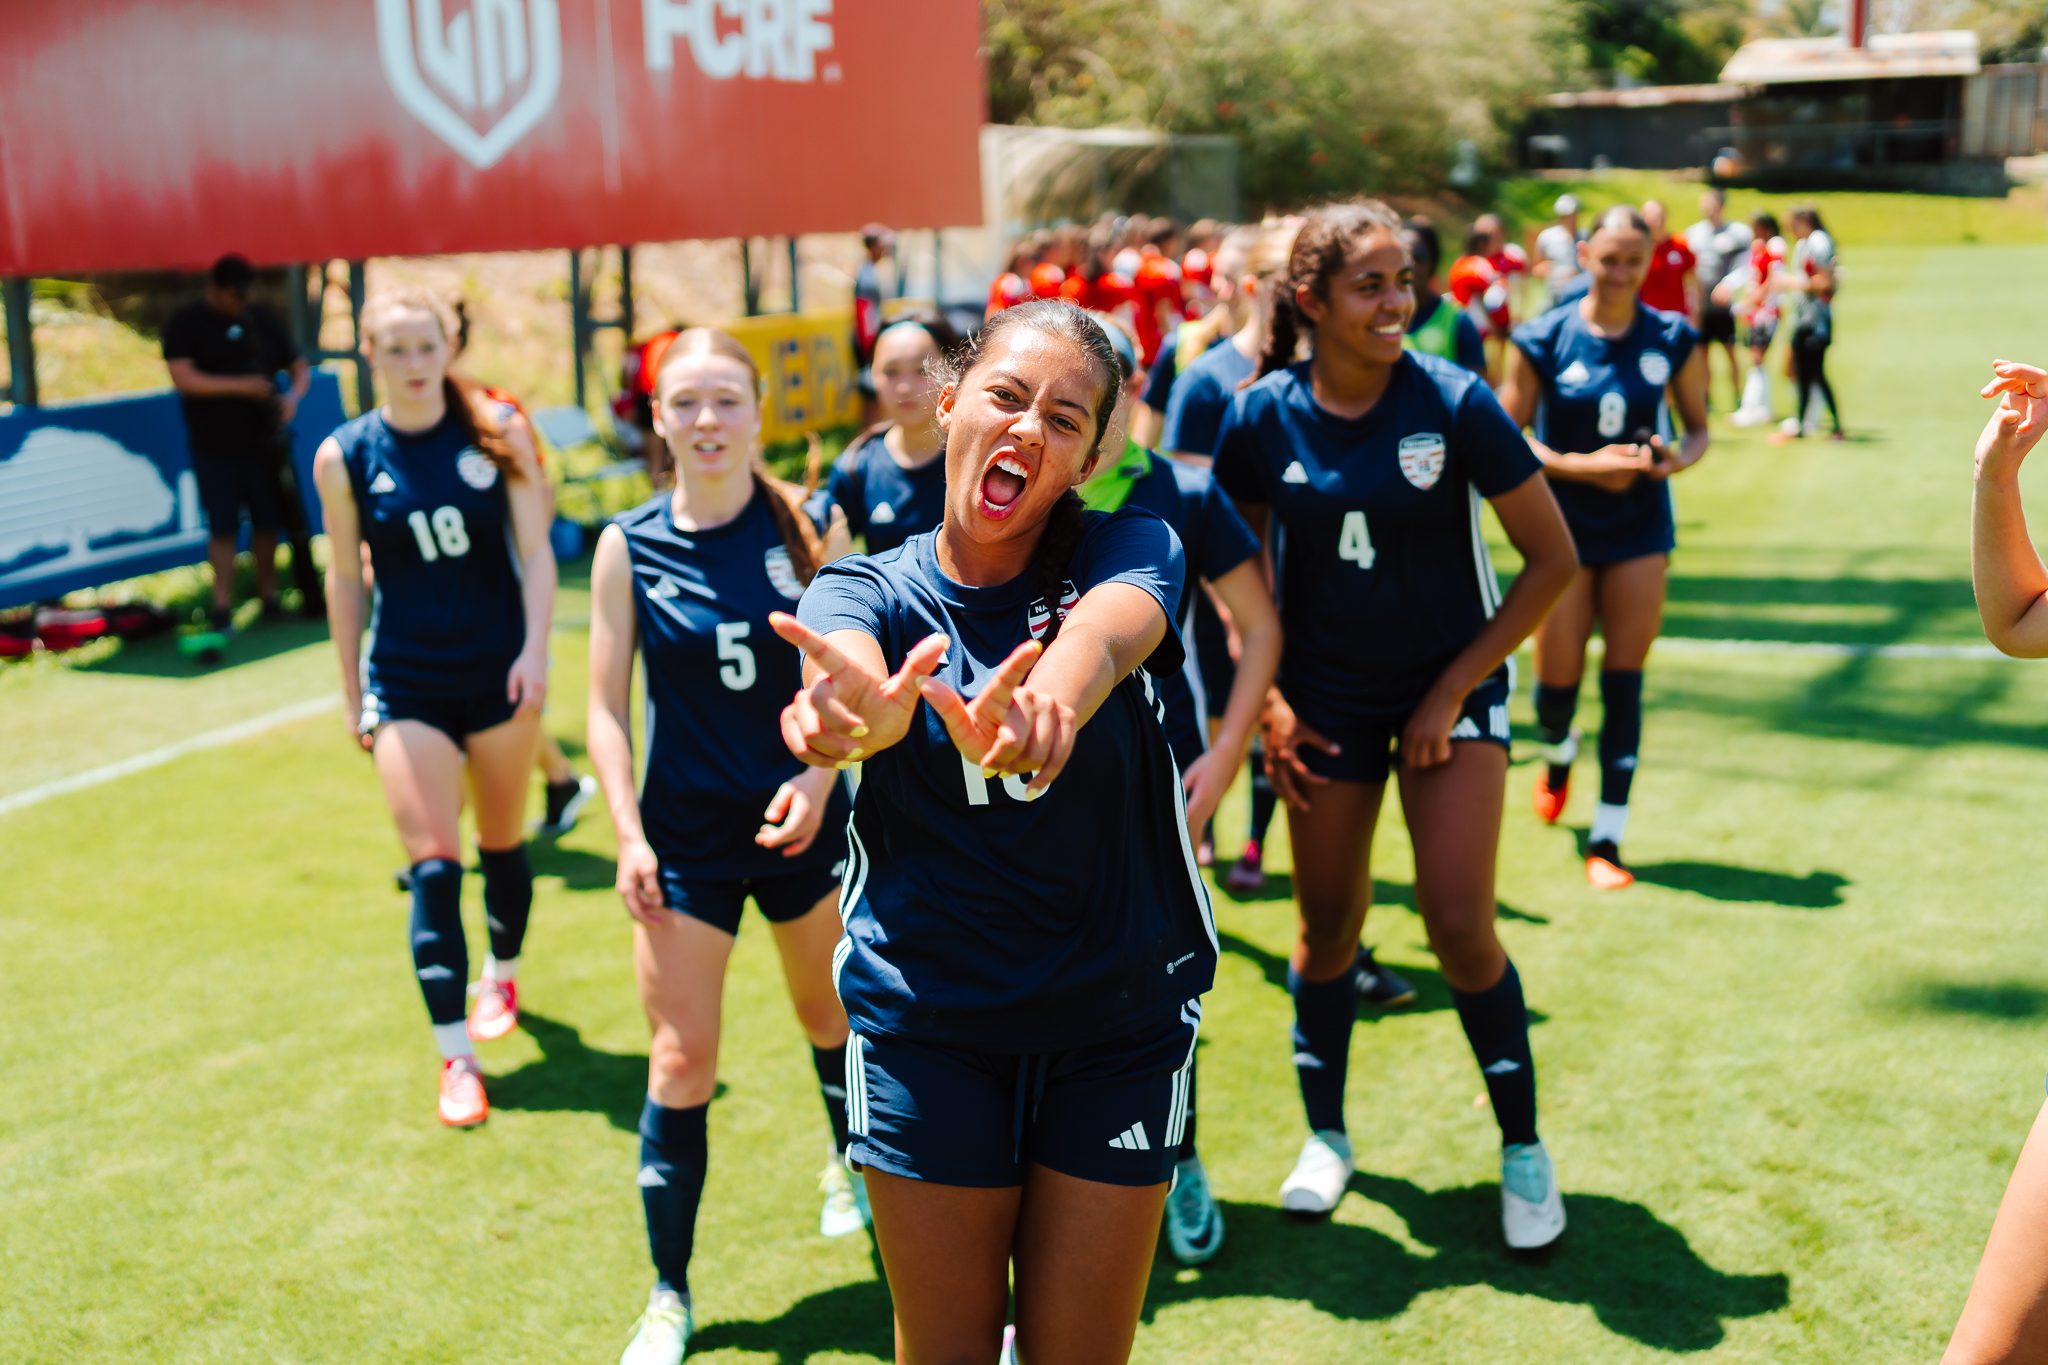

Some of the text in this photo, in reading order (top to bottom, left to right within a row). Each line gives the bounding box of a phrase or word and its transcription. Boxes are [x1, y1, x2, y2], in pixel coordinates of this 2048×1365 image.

[1598, 391, 1626, 437] 8
[407, 505, 470, 561] 18
[1338, 510, 1376, 569] 4
[715, 621, 757, 691] 5
[961, 752, 1050, 805] 1
